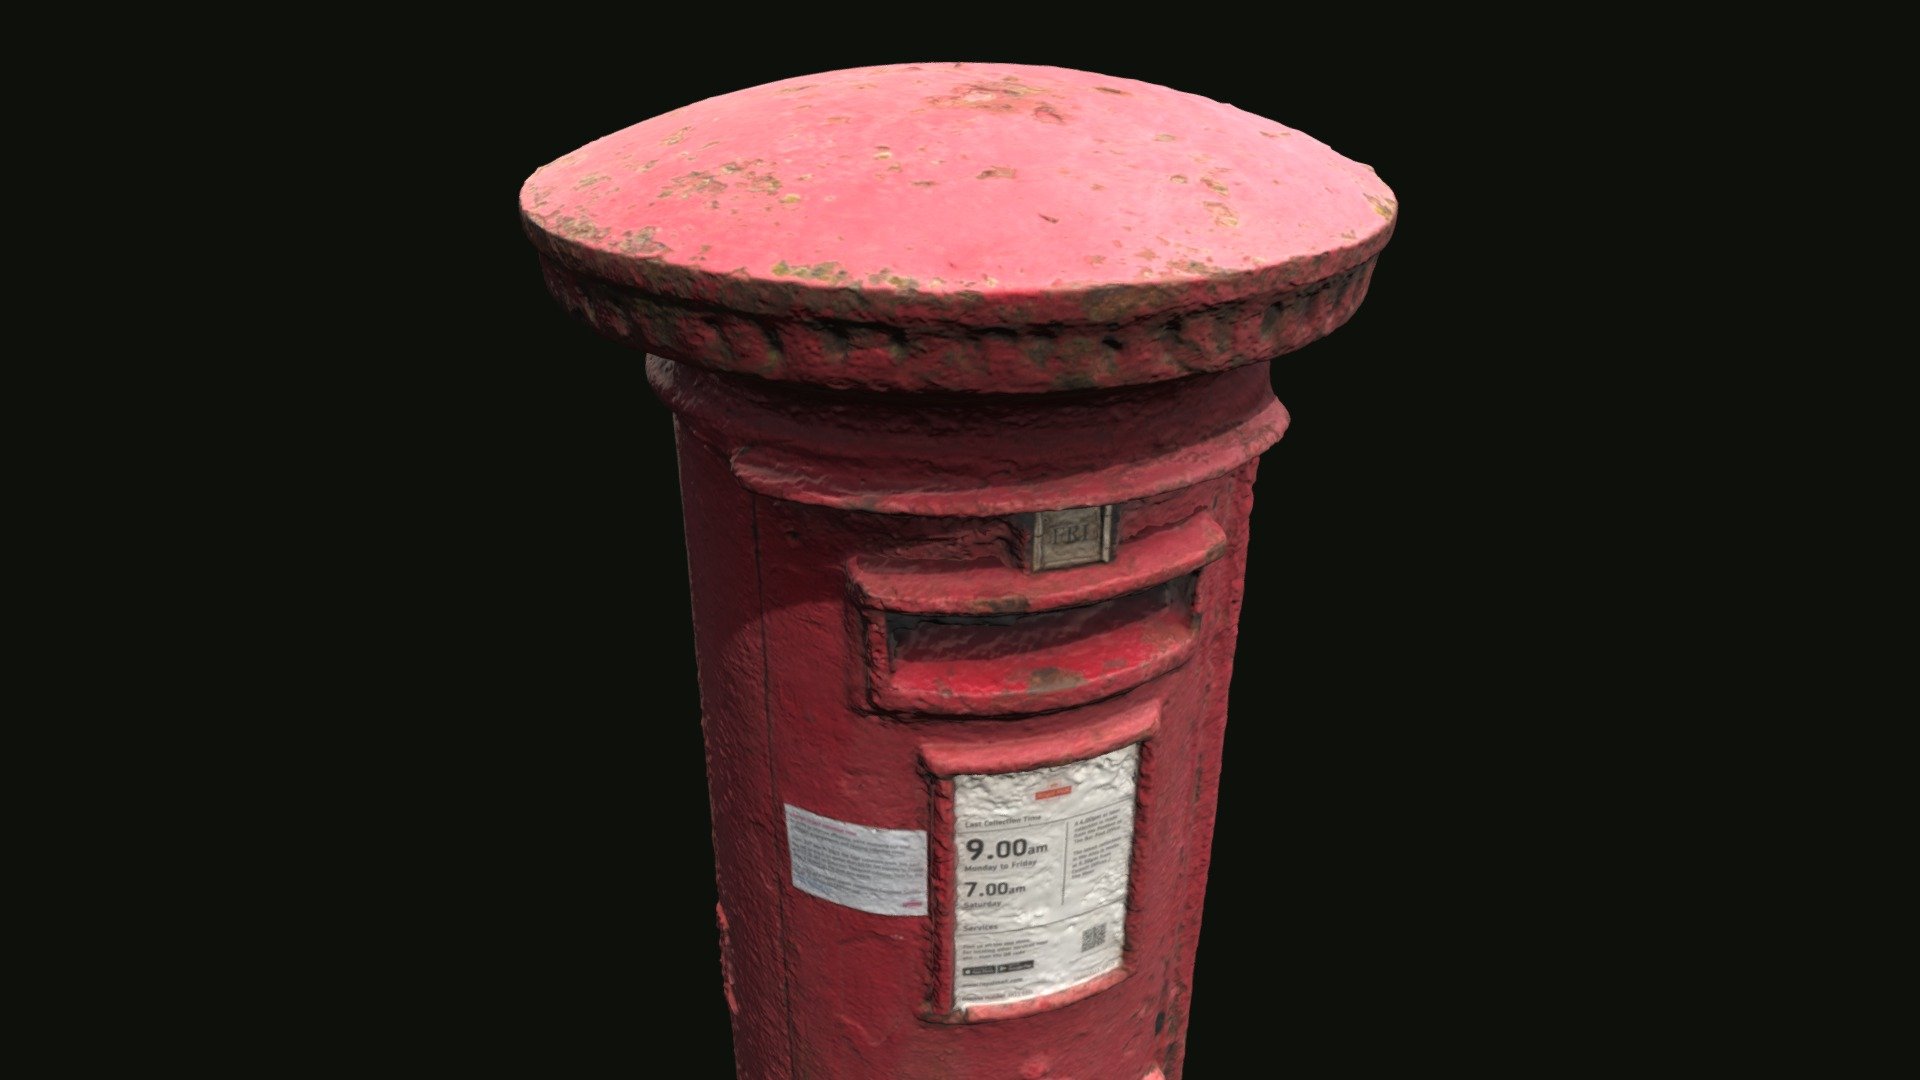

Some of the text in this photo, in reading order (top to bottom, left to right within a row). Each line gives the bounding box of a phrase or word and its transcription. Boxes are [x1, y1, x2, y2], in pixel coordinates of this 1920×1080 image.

[1052, 524, 1089, 544] FRI
[984, 817, 1021, 827] Collection
[966, 838, 1048, 860] 9.00am
[964, 864, 997, 872] Monday
[1012, 859, 1037, 868] Friday
[964, 882, 1026, 897] 7.00am
